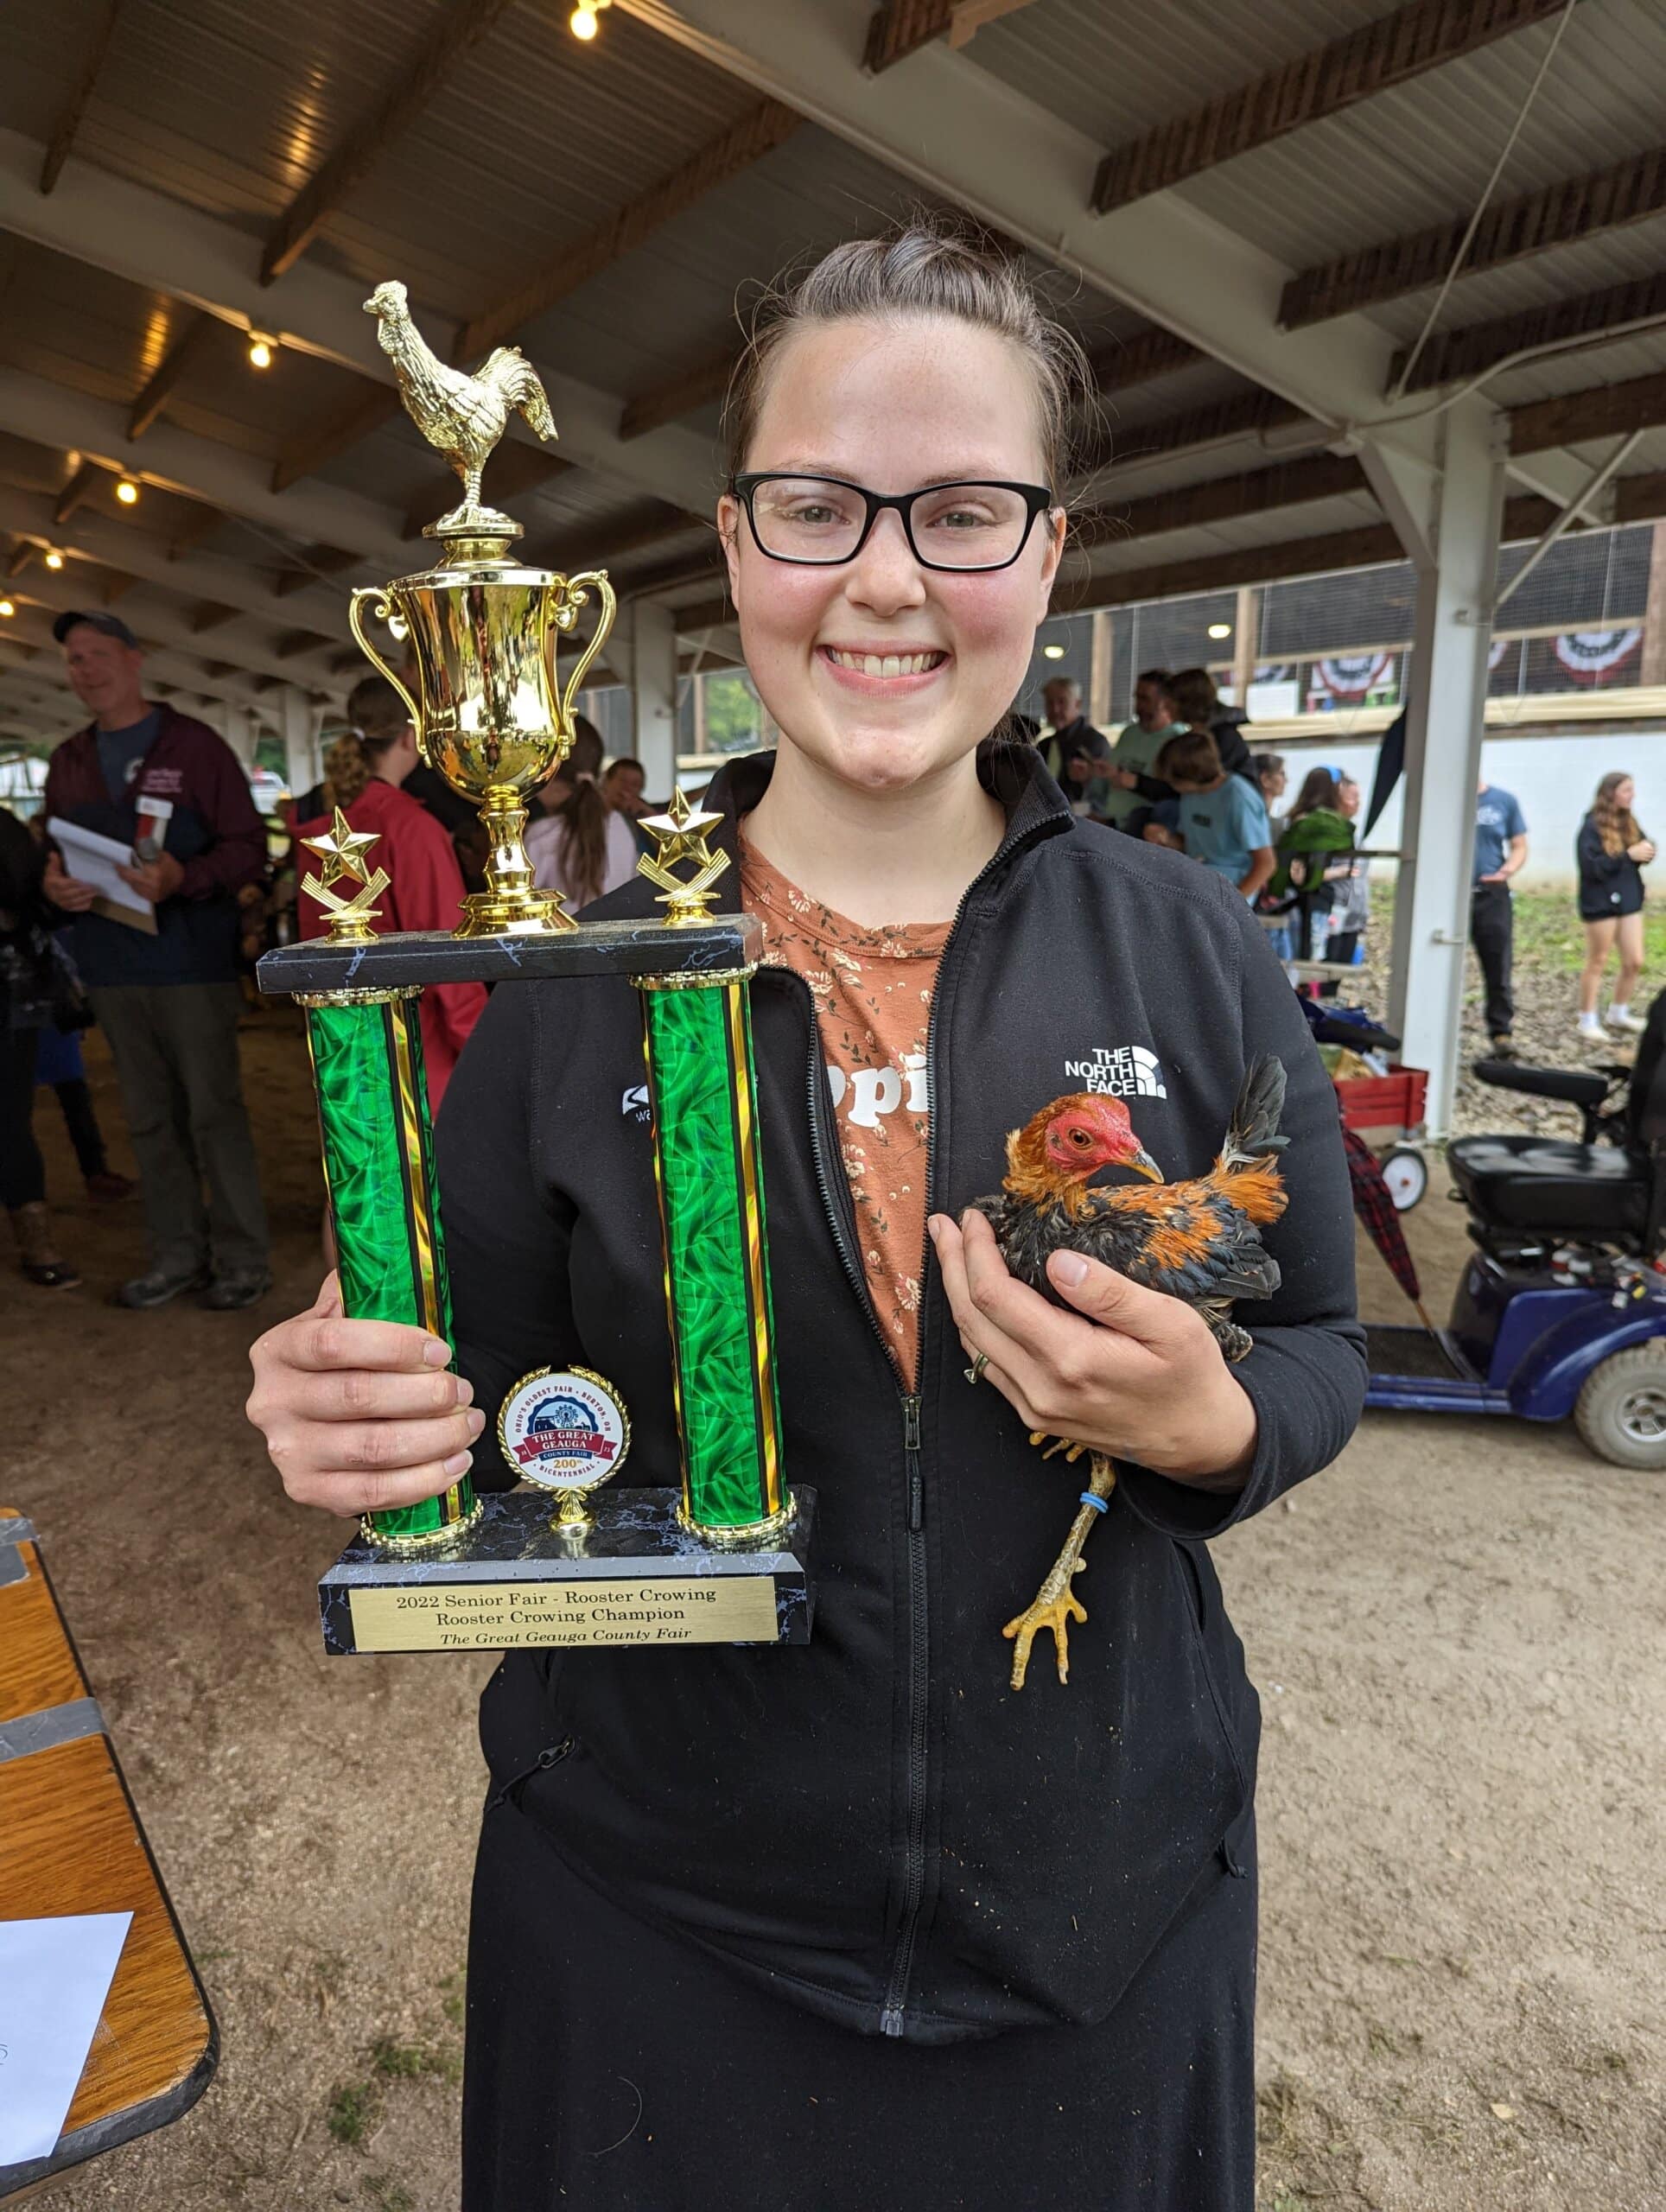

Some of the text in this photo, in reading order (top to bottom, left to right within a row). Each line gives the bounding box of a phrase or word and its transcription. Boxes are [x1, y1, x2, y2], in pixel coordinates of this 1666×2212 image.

[1092, 1046, 1132, 1065] THE
[1065, 1060, 1135, 1080] NORTH
[1086, 1078, 1137, 1096] FACE
[525, 1388, 551, 1407] OLDEST
[532, 1431, 595, 1443] THE GREAT
[542, 1440, 587, 1450] GEAUGA
[538, 1463, 595, 1478] BICENTENNIAL
[397, 1596, 439, 1609] 2022
[445, 1595, 503, 1608] Senior
[509, 1592, 547, 1605] Fair
[564, 1591, 633, 1604] Rooster
[639, 1588, 716, 1603] Crowing
[436, 1607, 685, 1625] Rooster Crowing Champion
[440, 1627, 692, 1645] The Great Geauga County Fair
